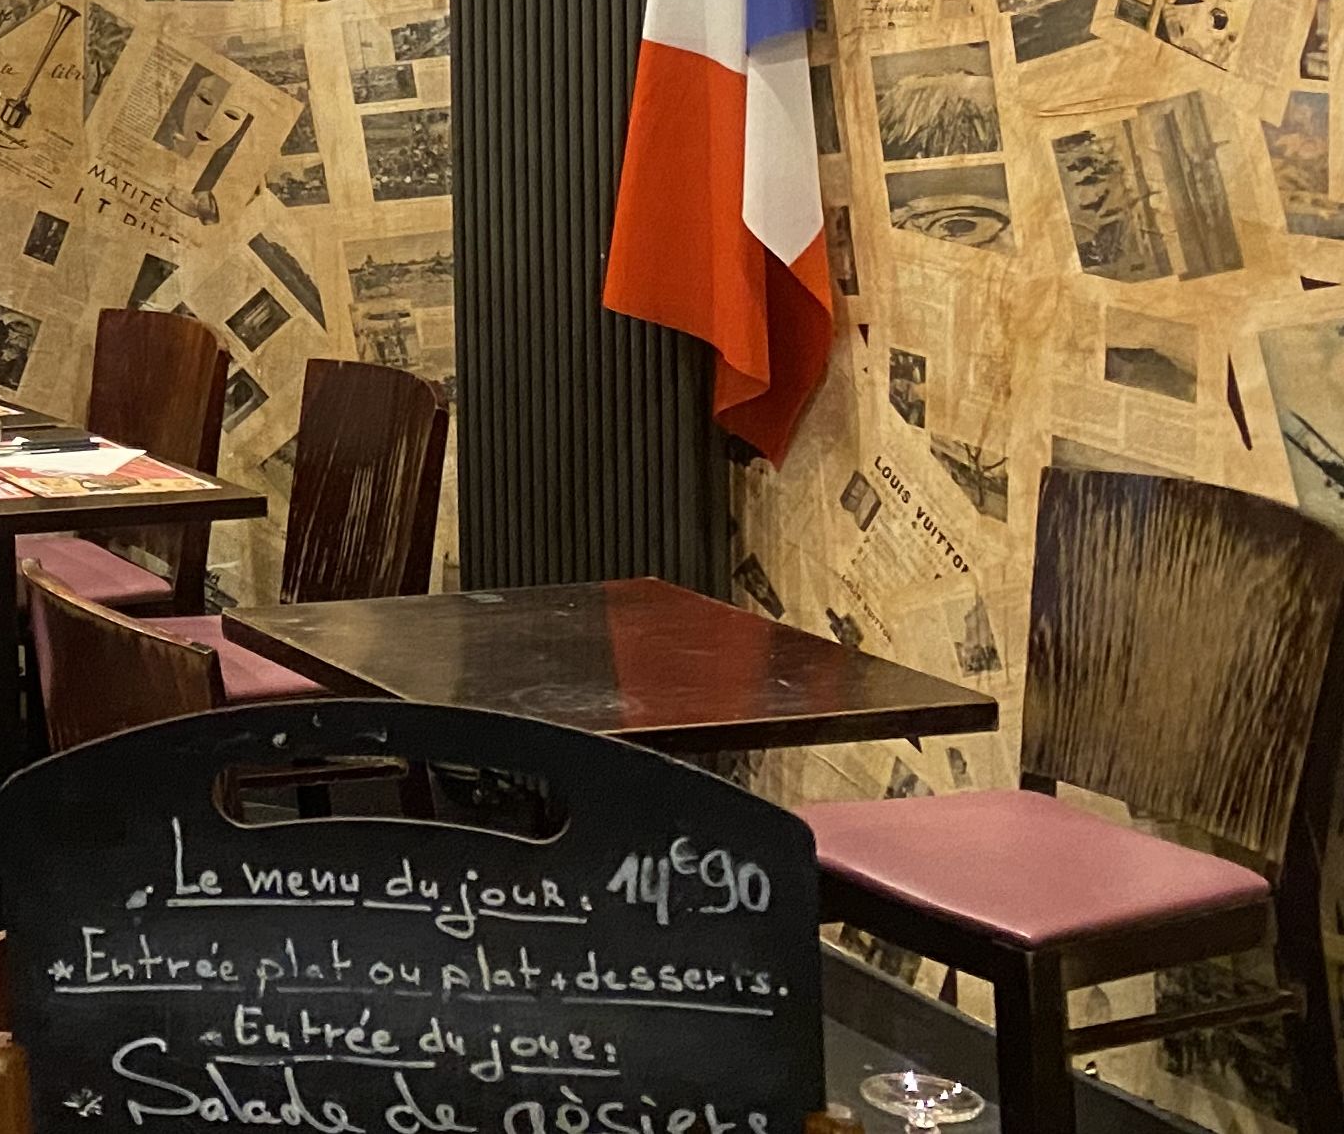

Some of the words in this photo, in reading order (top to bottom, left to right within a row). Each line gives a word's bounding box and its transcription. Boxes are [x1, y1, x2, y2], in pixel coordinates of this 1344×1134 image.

[875, 456, 911, 504] LOUIS
[173, 818, 222, 895] Le
[242, 862, 360, 895] menu
[386, 858, 439, 898] du
[82, 927, 238, 983] Entrée
[257, 937, 351, 998] plat
[370, 961, 420, 985] ou
[235, 1004, 400, 1054] Entrée
[419, 1016, 465, 1056] du
[112, 1037, 365, 1134] Salade
[385, 1071, 477, 1134] de
